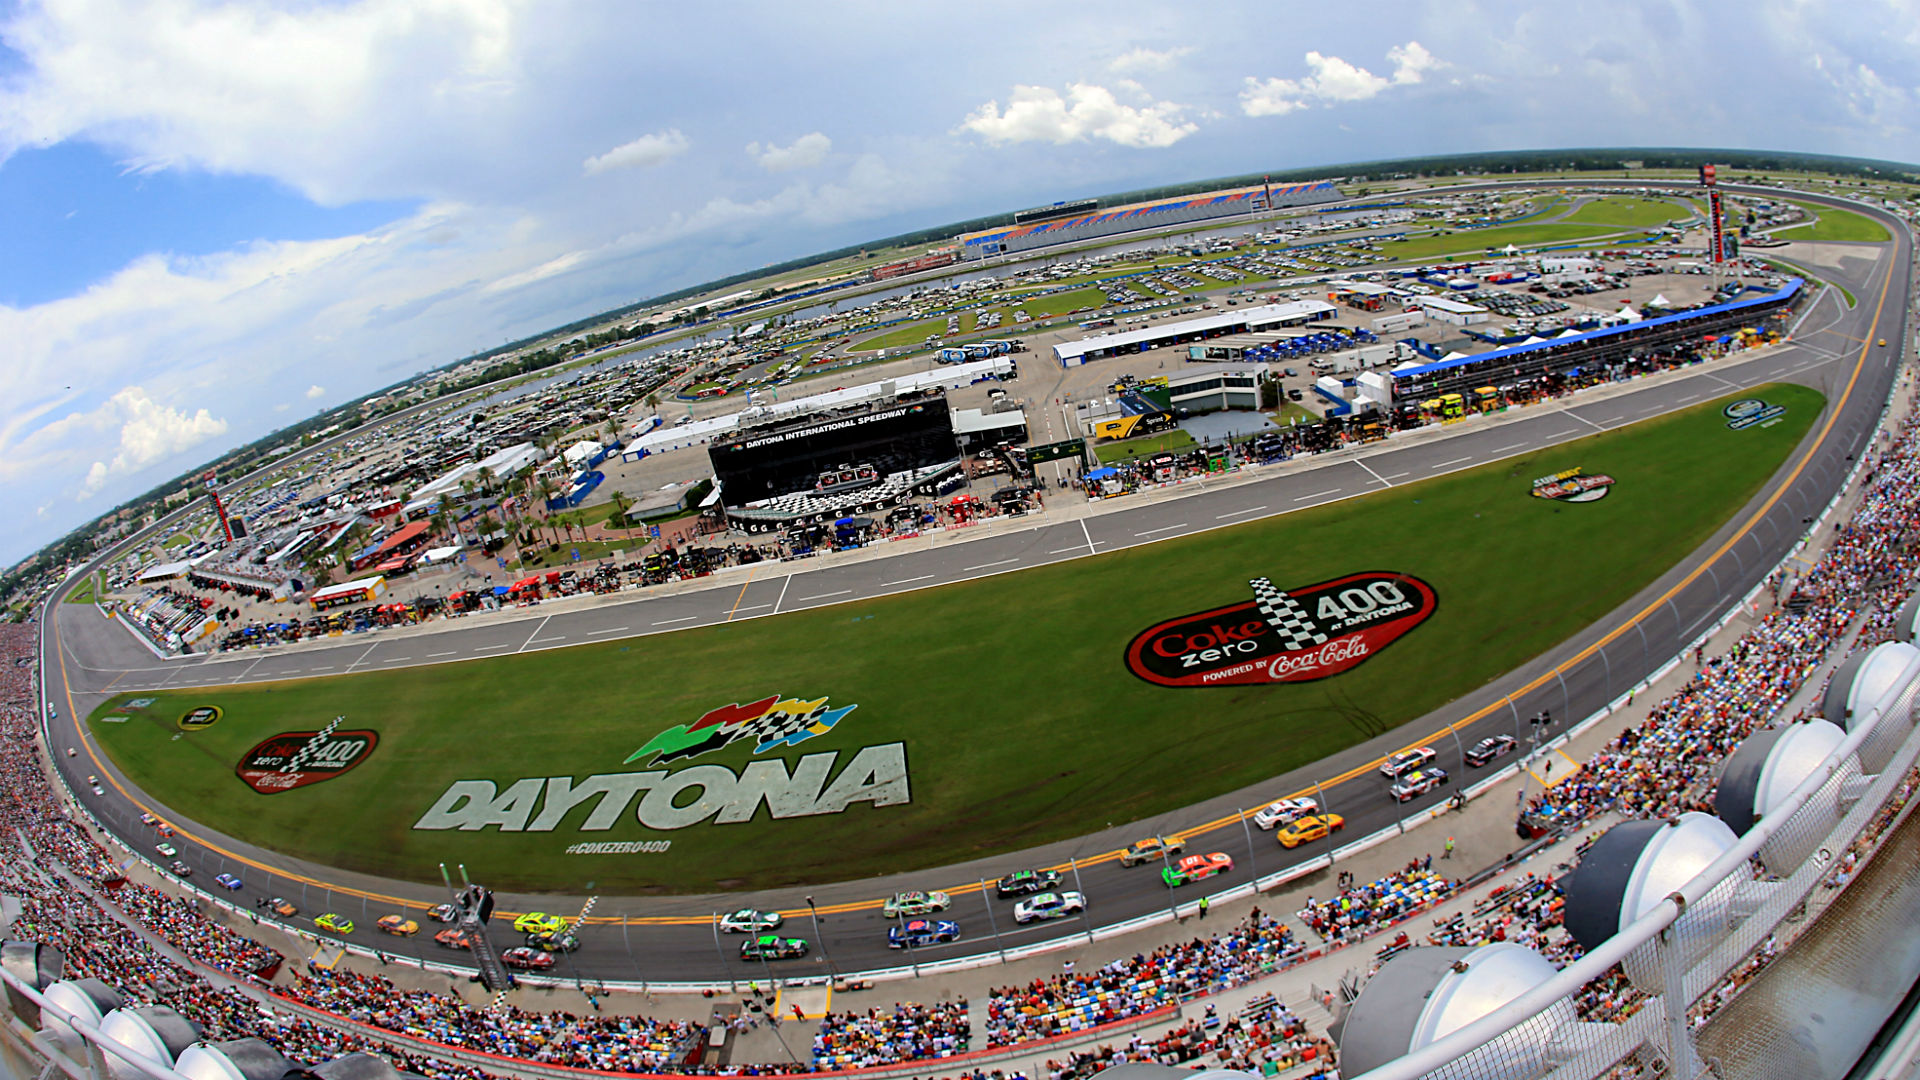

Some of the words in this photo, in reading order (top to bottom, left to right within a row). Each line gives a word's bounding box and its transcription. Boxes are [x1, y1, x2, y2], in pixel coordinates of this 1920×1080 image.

[746, 434, 784, 449] DAYTONA
[785, 419, 856, 441] INTERNATIONAL
[857, 408, 907, 425] SPEEDWAY
[1145, 416, 1164, 426] Sprint
[1533, 466, 1582, 488] SUBWAY
[876, 502, 883, 510] G
[750, 524, 758, 532] G
[761, 524, 768, 532] G
[1317, 581, 1406, 620] 400
[1331, 623, 1343, 631] AT
[1344, 601, 1414, 627] DAYTONA
[1152, 621, 1269, 658] Coke
[1180, 640, 1258, 668] zero
[1202, 663, 1254, 683] POWERED
[1255, 660, 1268, 669] BY
[1268, 634, 1370, 679] Coca-Cola
[256, 742, 302, 757] Coke
[312, 740, 366, 762] 400
[252, 757, 283, 766] zero
[412, 741, 911, 832] DAYTONA
[565, 840, 672, 855] #COKEZERO400
